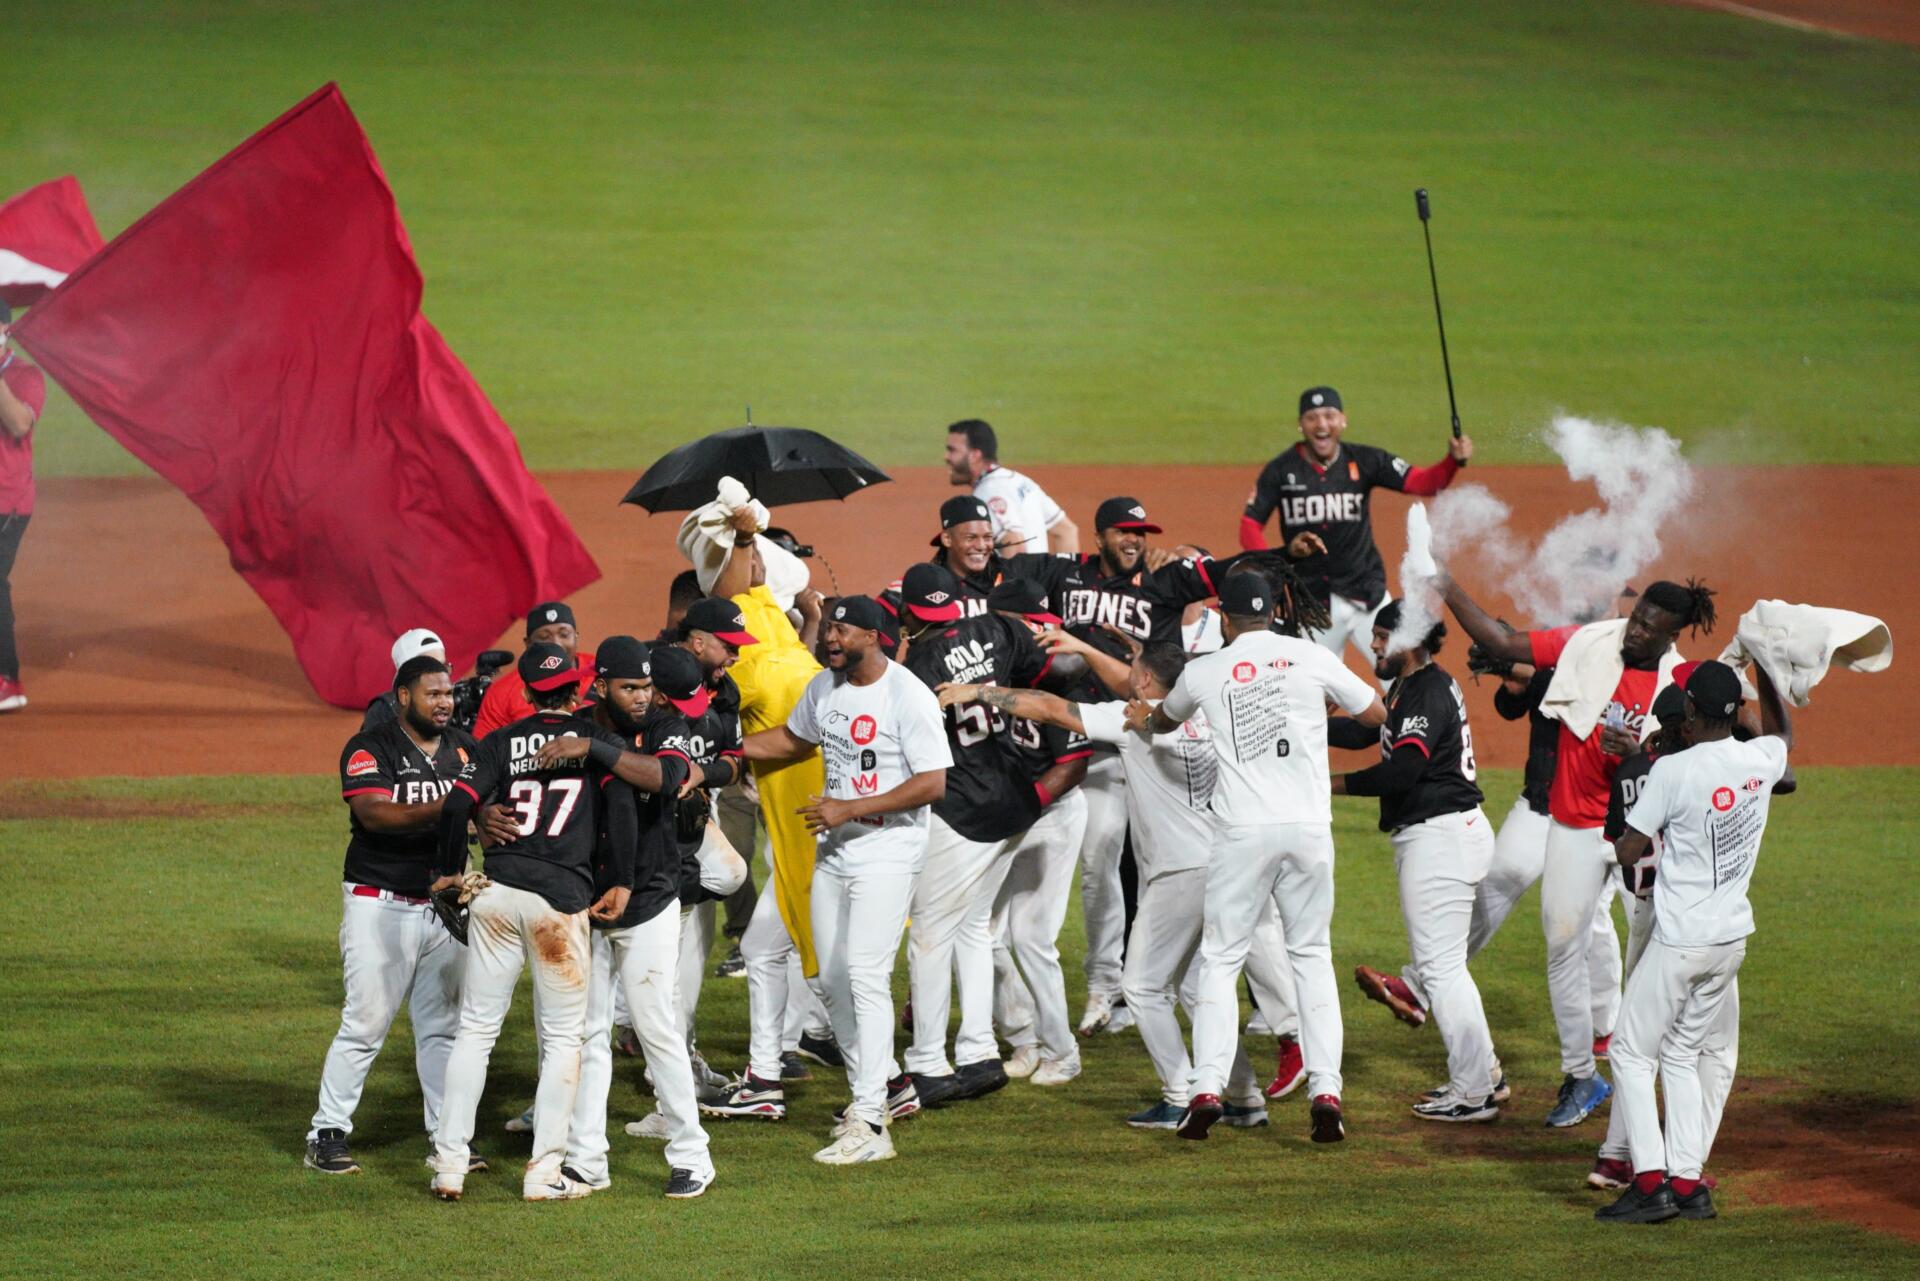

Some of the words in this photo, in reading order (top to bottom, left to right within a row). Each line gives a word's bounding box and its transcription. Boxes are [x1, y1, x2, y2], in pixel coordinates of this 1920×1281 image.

[1062, 589, 1152, 640] LEONES
[1233, 684, 1262, 700] talento
[1236, 711, 1263, 728] equipo
[509, 779, 582, 836] 37
[1715, 810, 1742, 831] talento
[1717, 837, 1744, 857] equipo
